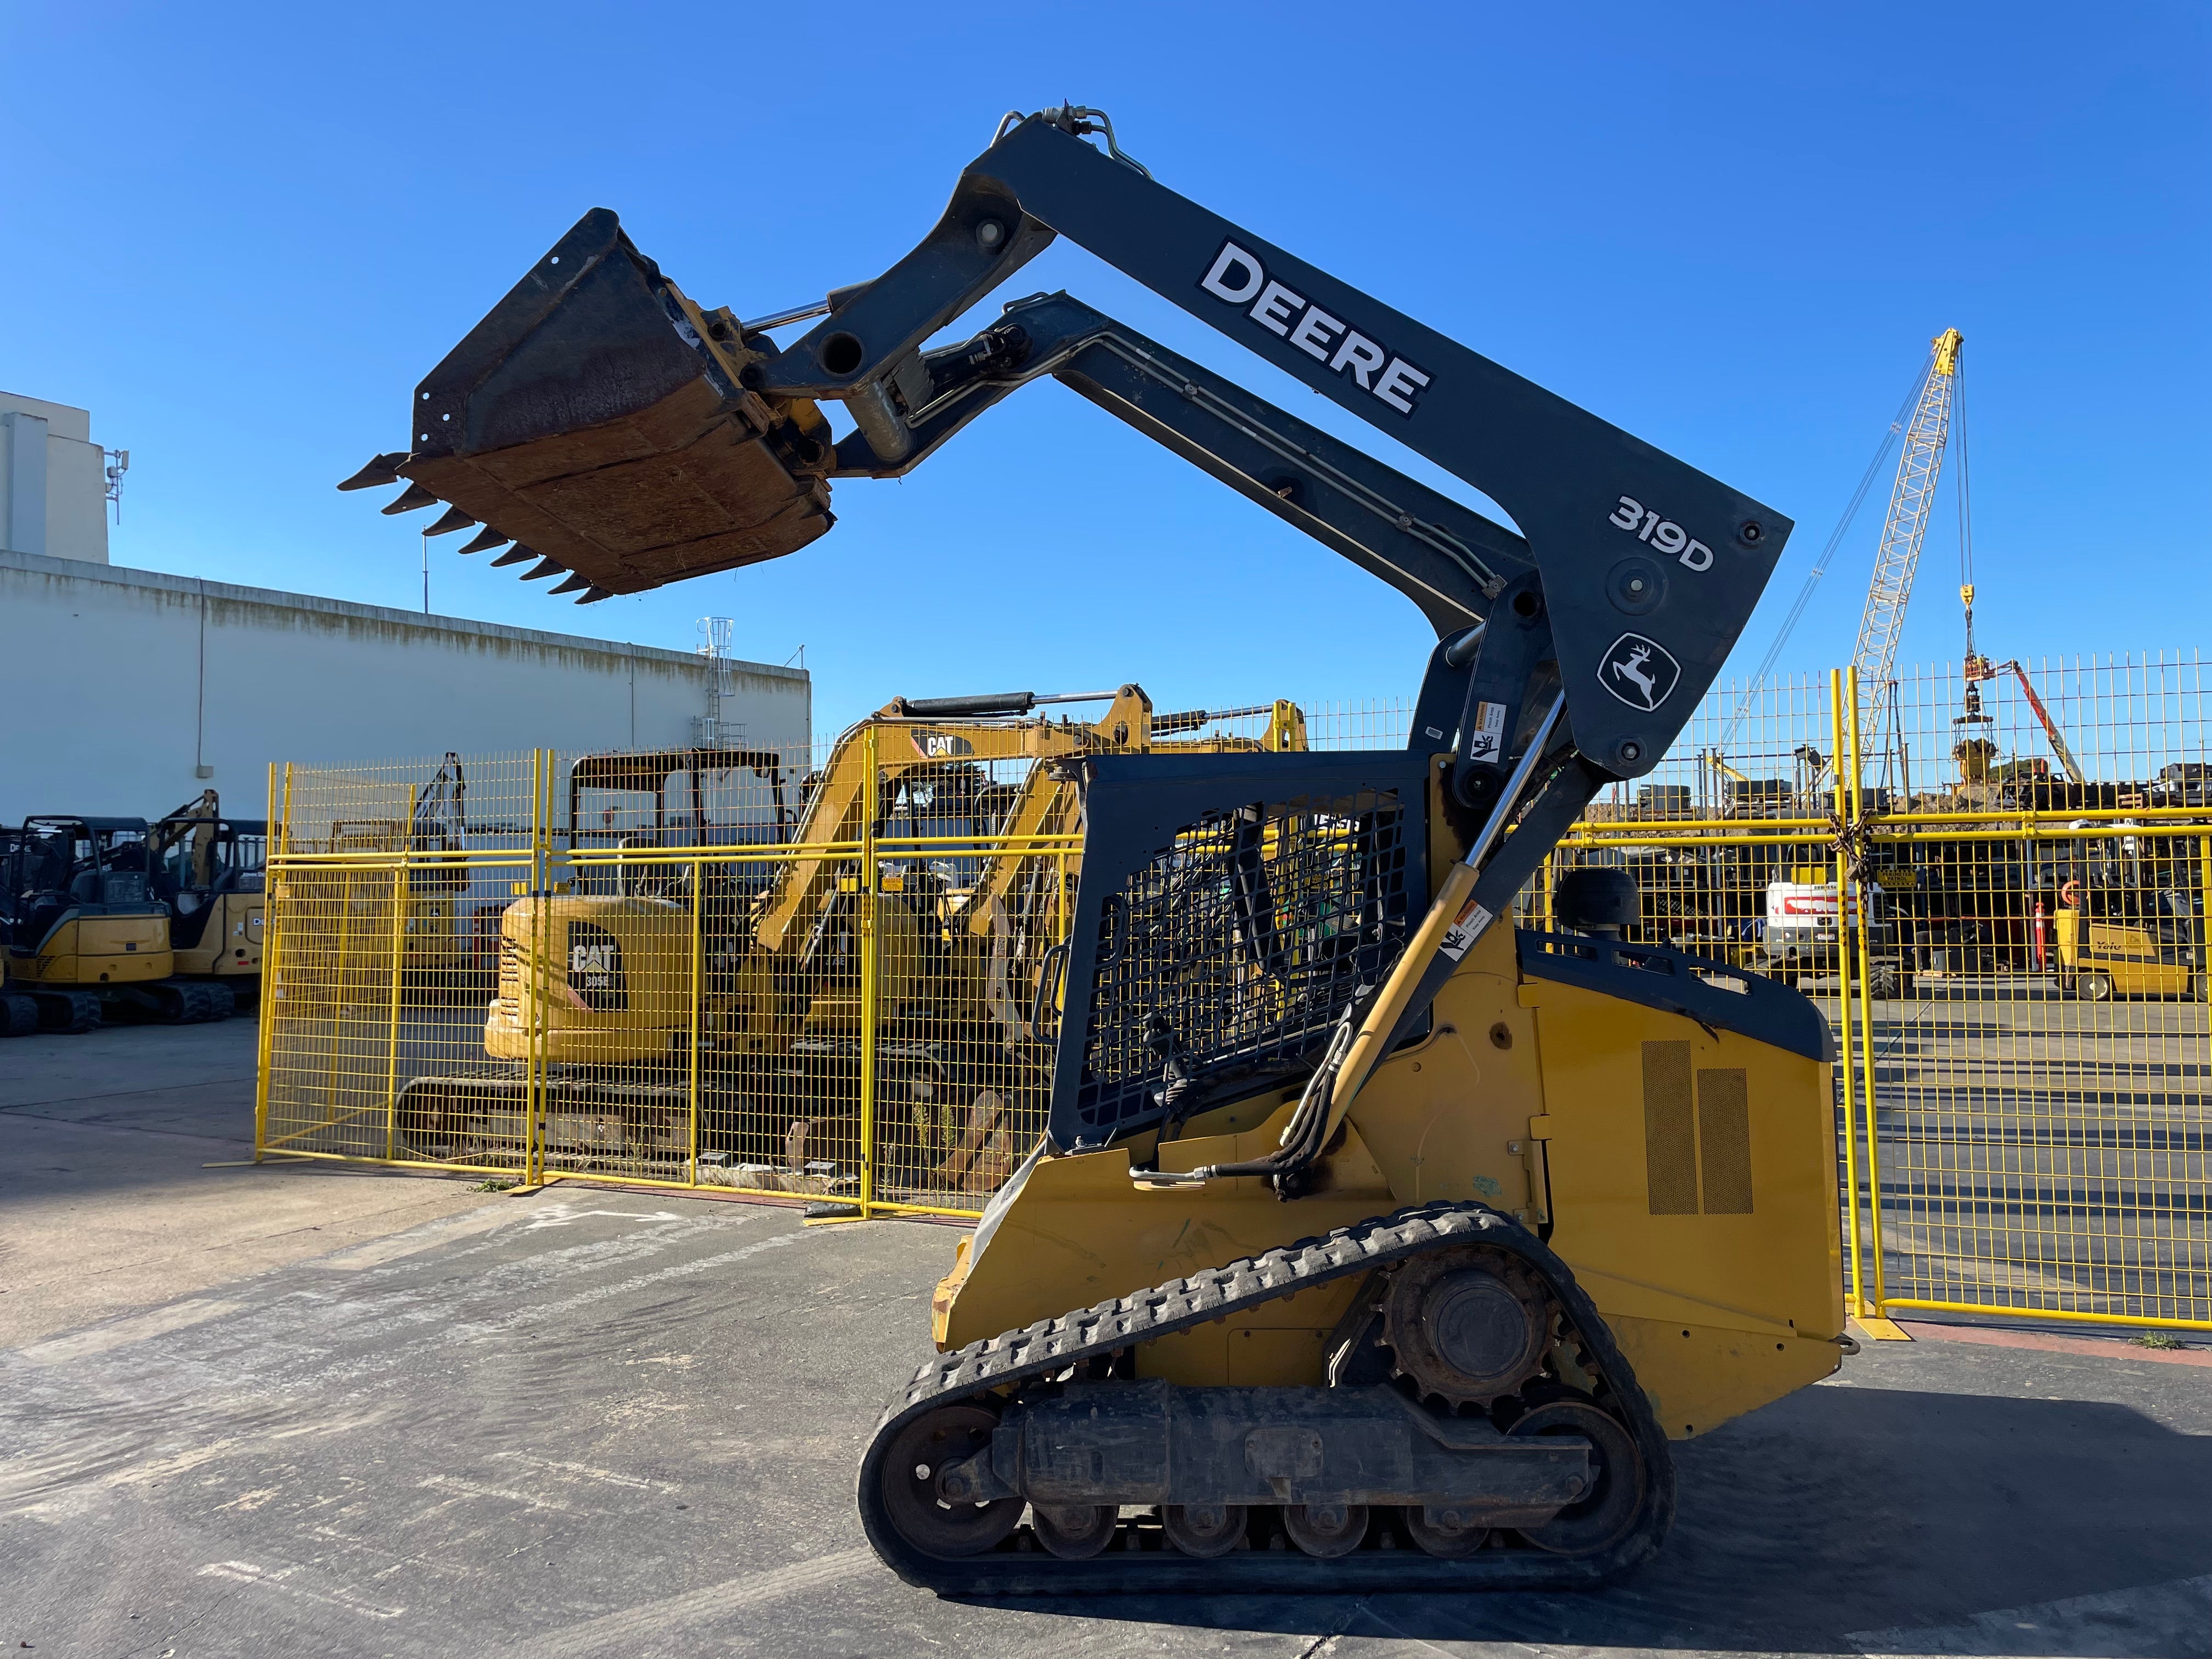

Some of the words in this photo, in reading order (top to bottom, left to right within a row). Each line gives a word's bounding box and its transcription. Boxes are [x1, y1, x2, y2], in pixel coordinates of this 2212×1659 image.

[1201, 241, 1430, 414] DEERE
[1609, 495, 1714, 572] 319D
[928, 736, 953, 757] CAT
[573, 945, 614, 972] CAT
[2096, 941, 2121, 950] Yale
